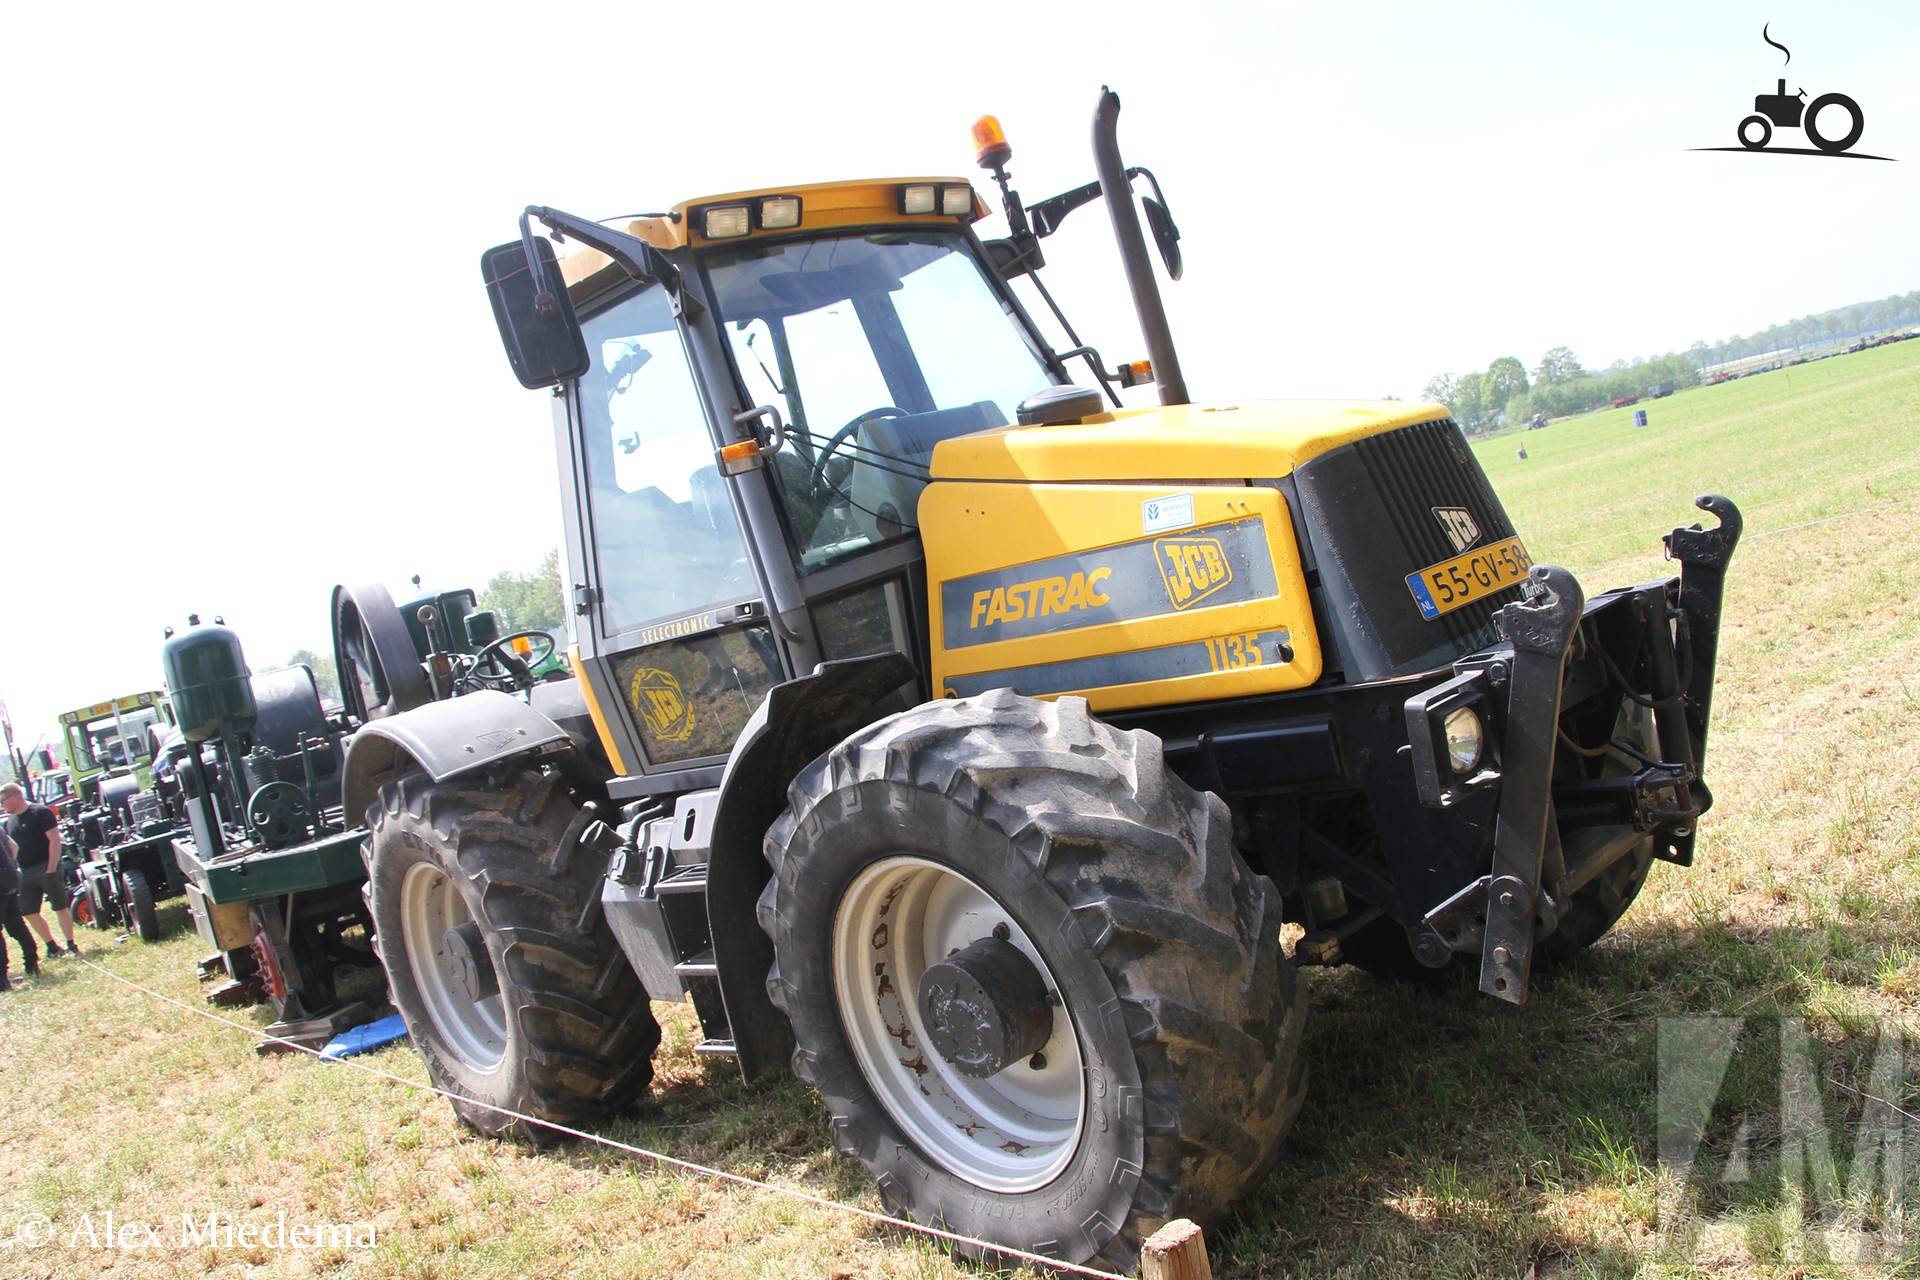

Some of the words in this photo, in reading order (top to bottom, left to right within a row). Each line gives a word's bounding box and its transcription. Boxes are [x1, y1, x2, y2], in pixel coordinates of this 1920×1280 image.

[1438, 511, 1478, 553] JCB
[1167, 546, 1225, 600] JCB
[1432, 544, 1528, 603] 55-GV-58
[970, 566, 1111, 630] FASTRAC
[1420, 601, 1435, 611] NL
[641, 616, 711, 644] SELECTRONIC
[1207, 635, 1262, 674] 1135
[645, 689, 684, 726] JCB
